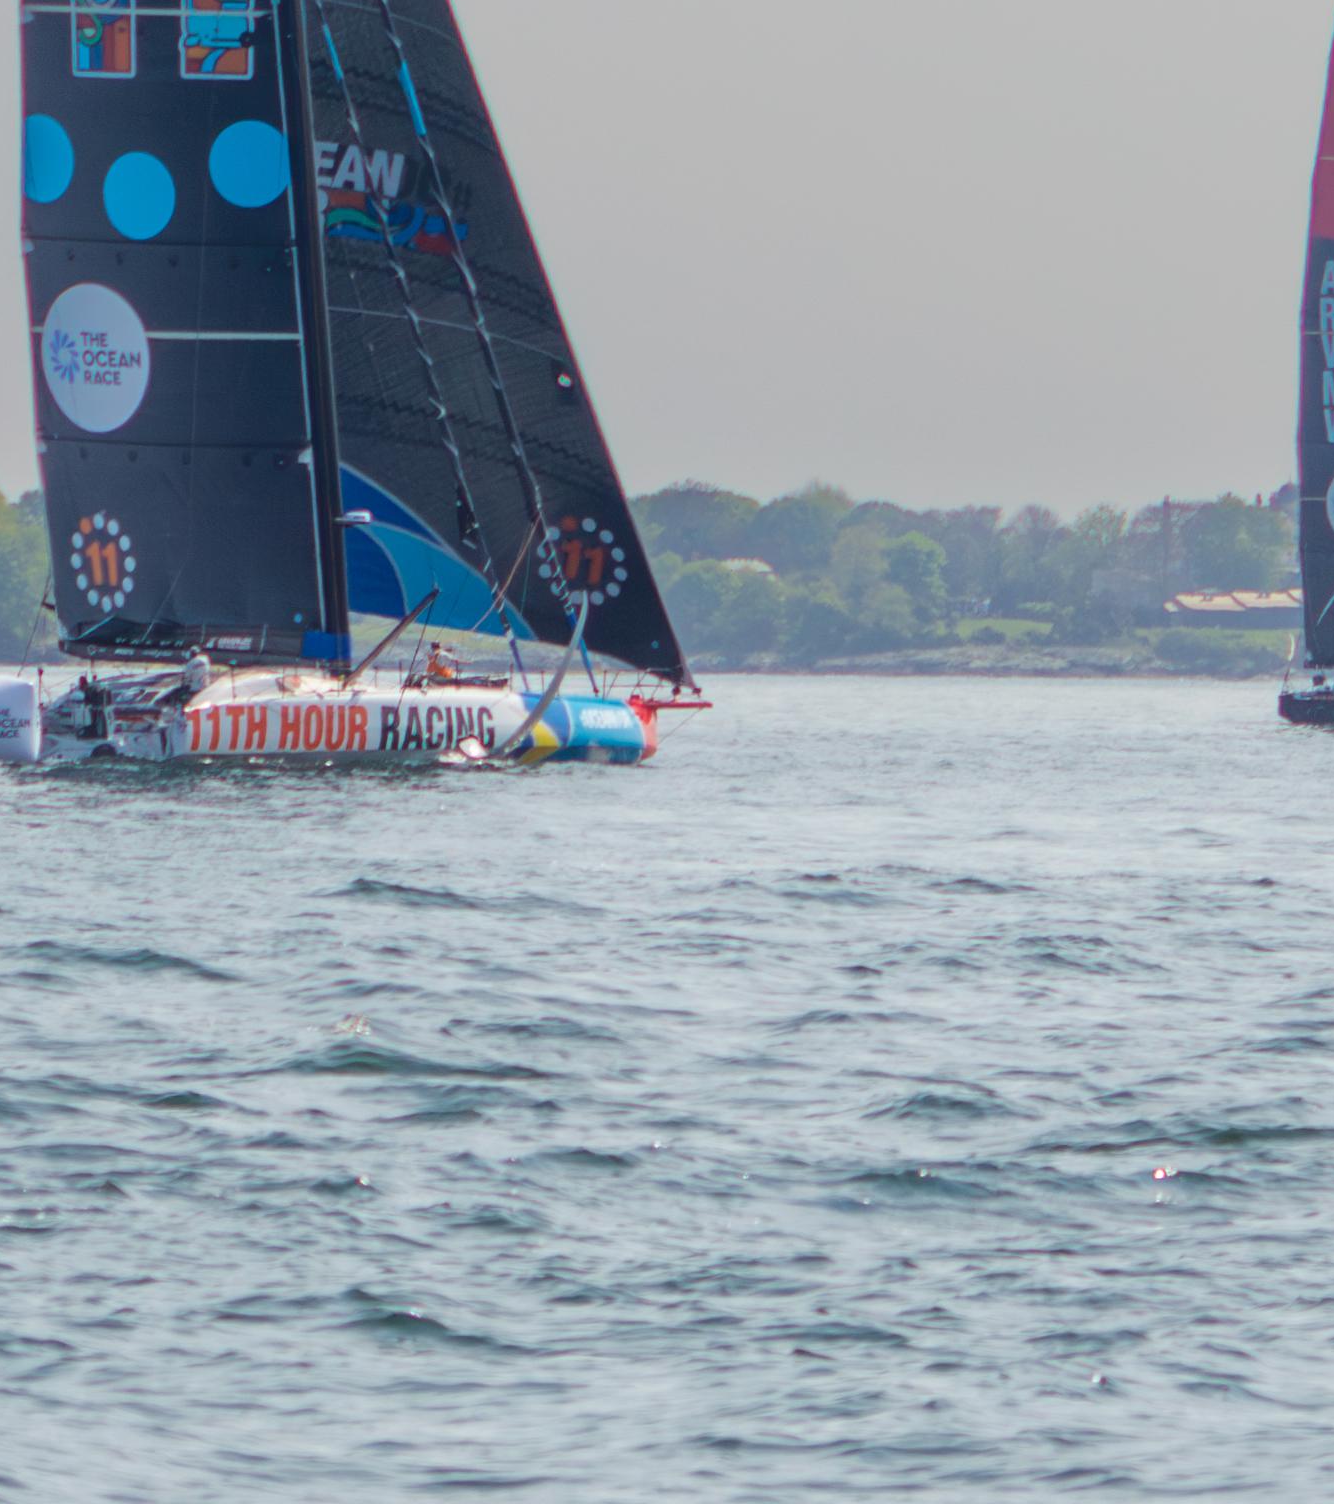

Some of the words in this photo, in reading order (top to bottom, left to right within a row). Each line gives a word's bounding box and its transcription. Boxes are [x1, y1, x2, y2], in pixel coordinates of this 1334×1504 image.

[80, 331, 109, 347] THE
[82, 349, 141, 368] OCEAN
[84, 370, 121, 385] RACE
[85, 539, 118, 586] 11
[562, 539, 604, 585] 11
[185, 704, 267, 752] 11TH
[278, 704, 368, 752] HOUR
[378, 705, 496, 750] RACING
